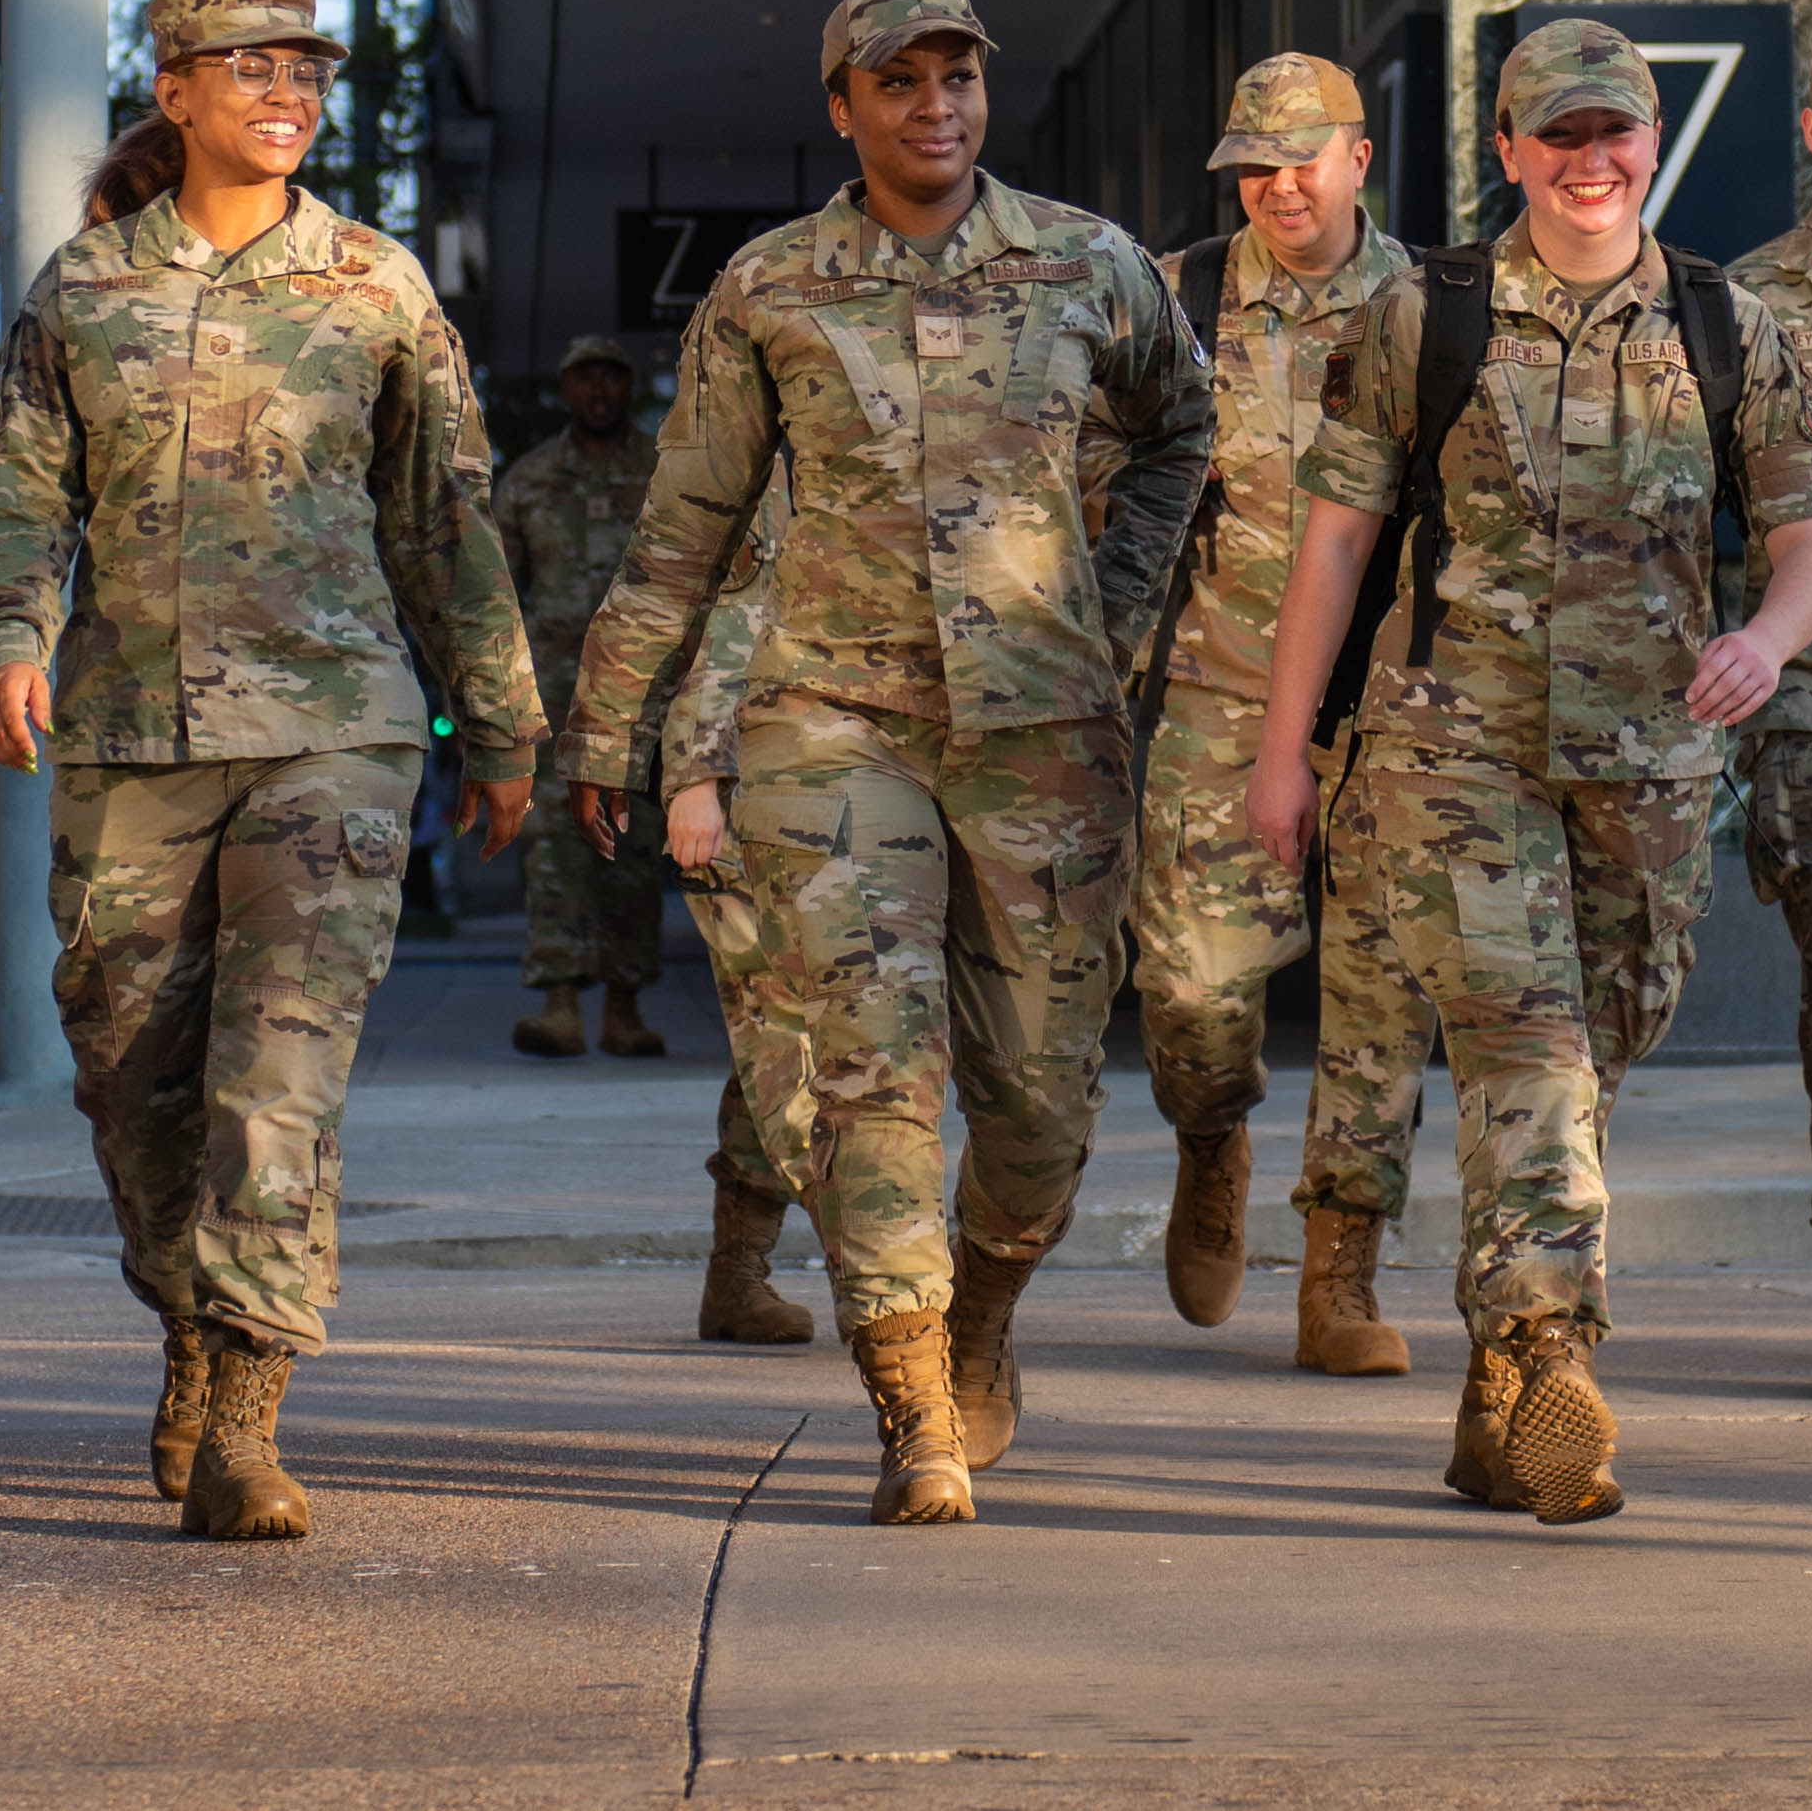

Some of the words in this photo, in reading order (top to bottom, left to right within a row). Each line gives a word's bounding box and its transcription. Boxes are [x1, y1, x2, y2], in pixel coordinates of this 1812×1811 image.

[1020, 261, 1041, 278] AIR
[1043, 259, 1087, 278] FORCE
[349, 282, 393, 309] FORCE
[802, 279, 855, 303] MARTIN
[1658, 341, 1679, 361] AIR
